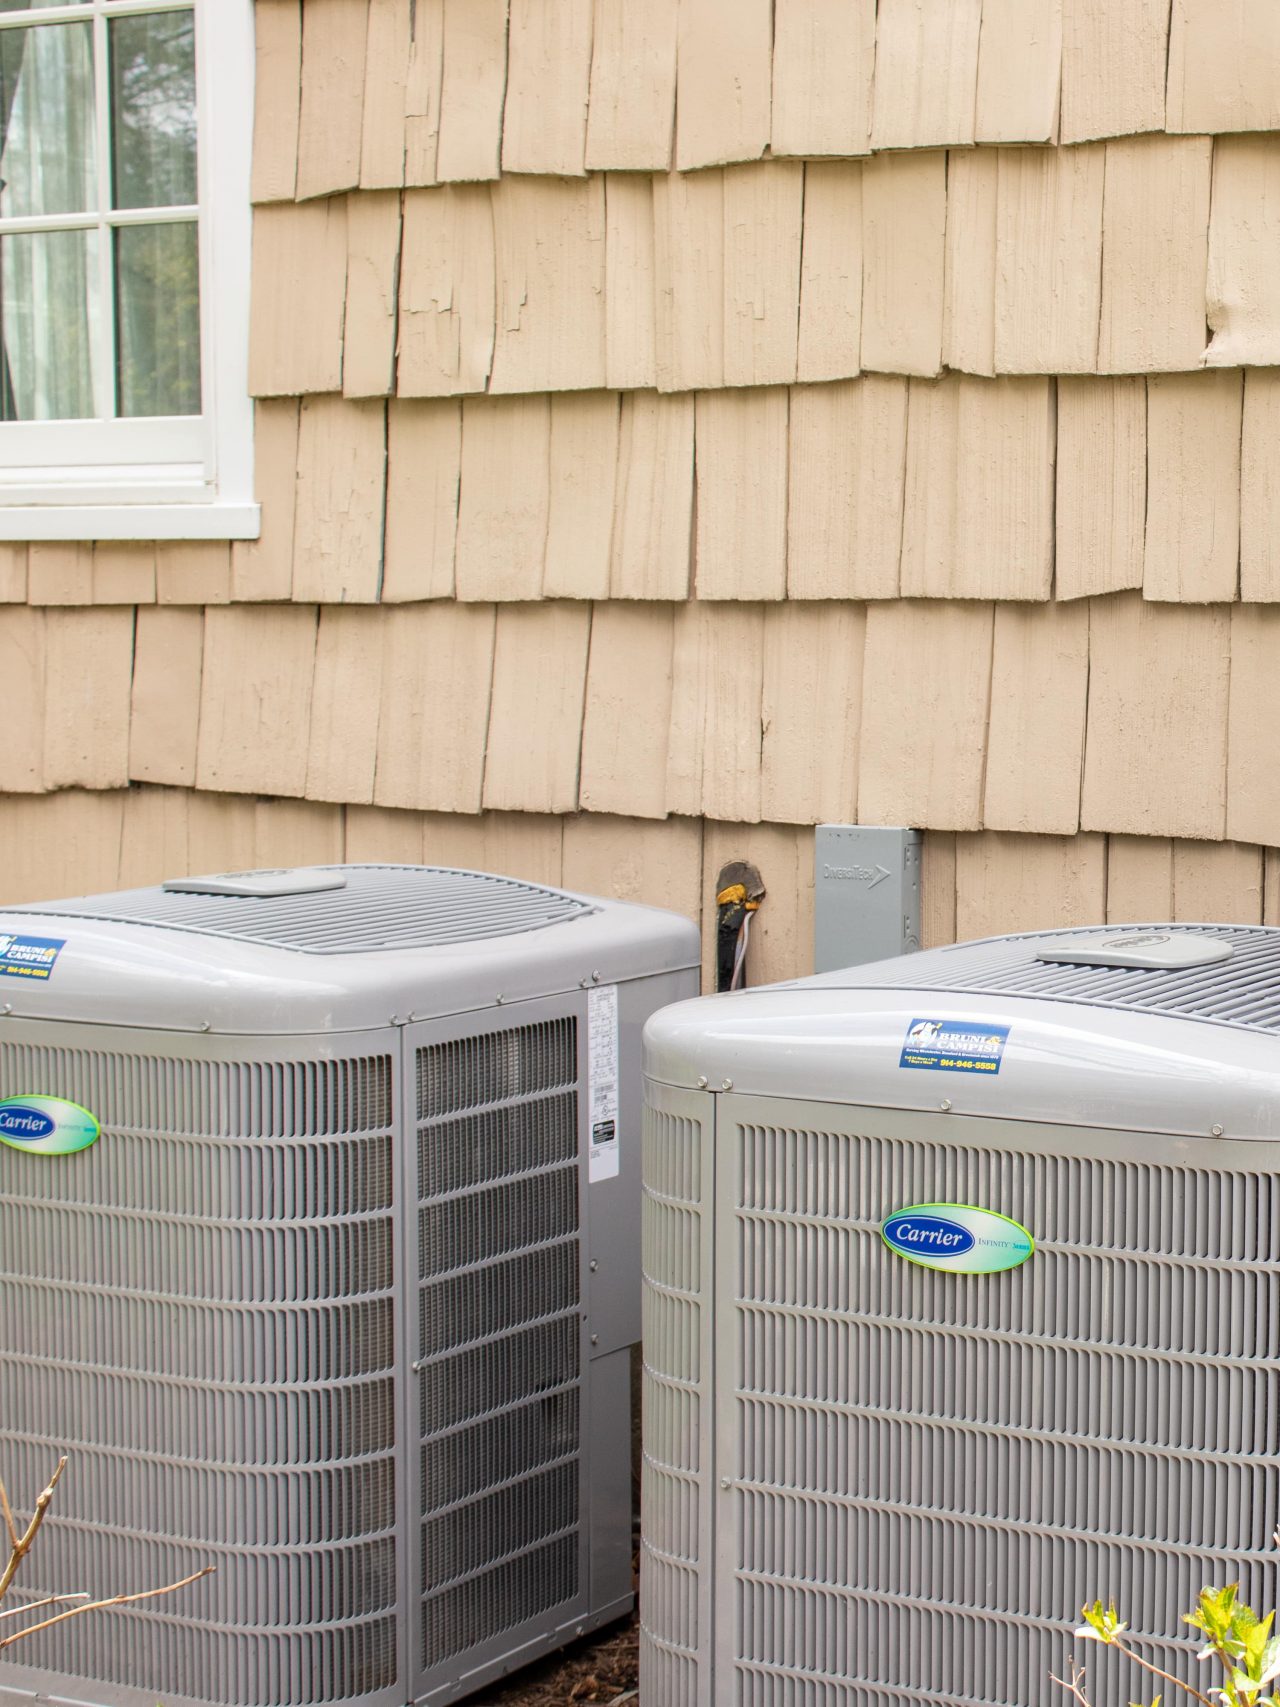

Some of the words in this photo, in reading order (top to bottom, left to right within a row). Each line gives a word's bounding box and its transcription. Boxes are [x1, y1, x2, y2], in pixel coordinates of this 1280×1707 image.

[937, 1041, 1000, 1053] CAMPISI
[940, 1059, 996, 1070] 914-946-5558
[0, 1112, 47, 1131] Carrier
[896, 1223, 963, 1246] Carrier
